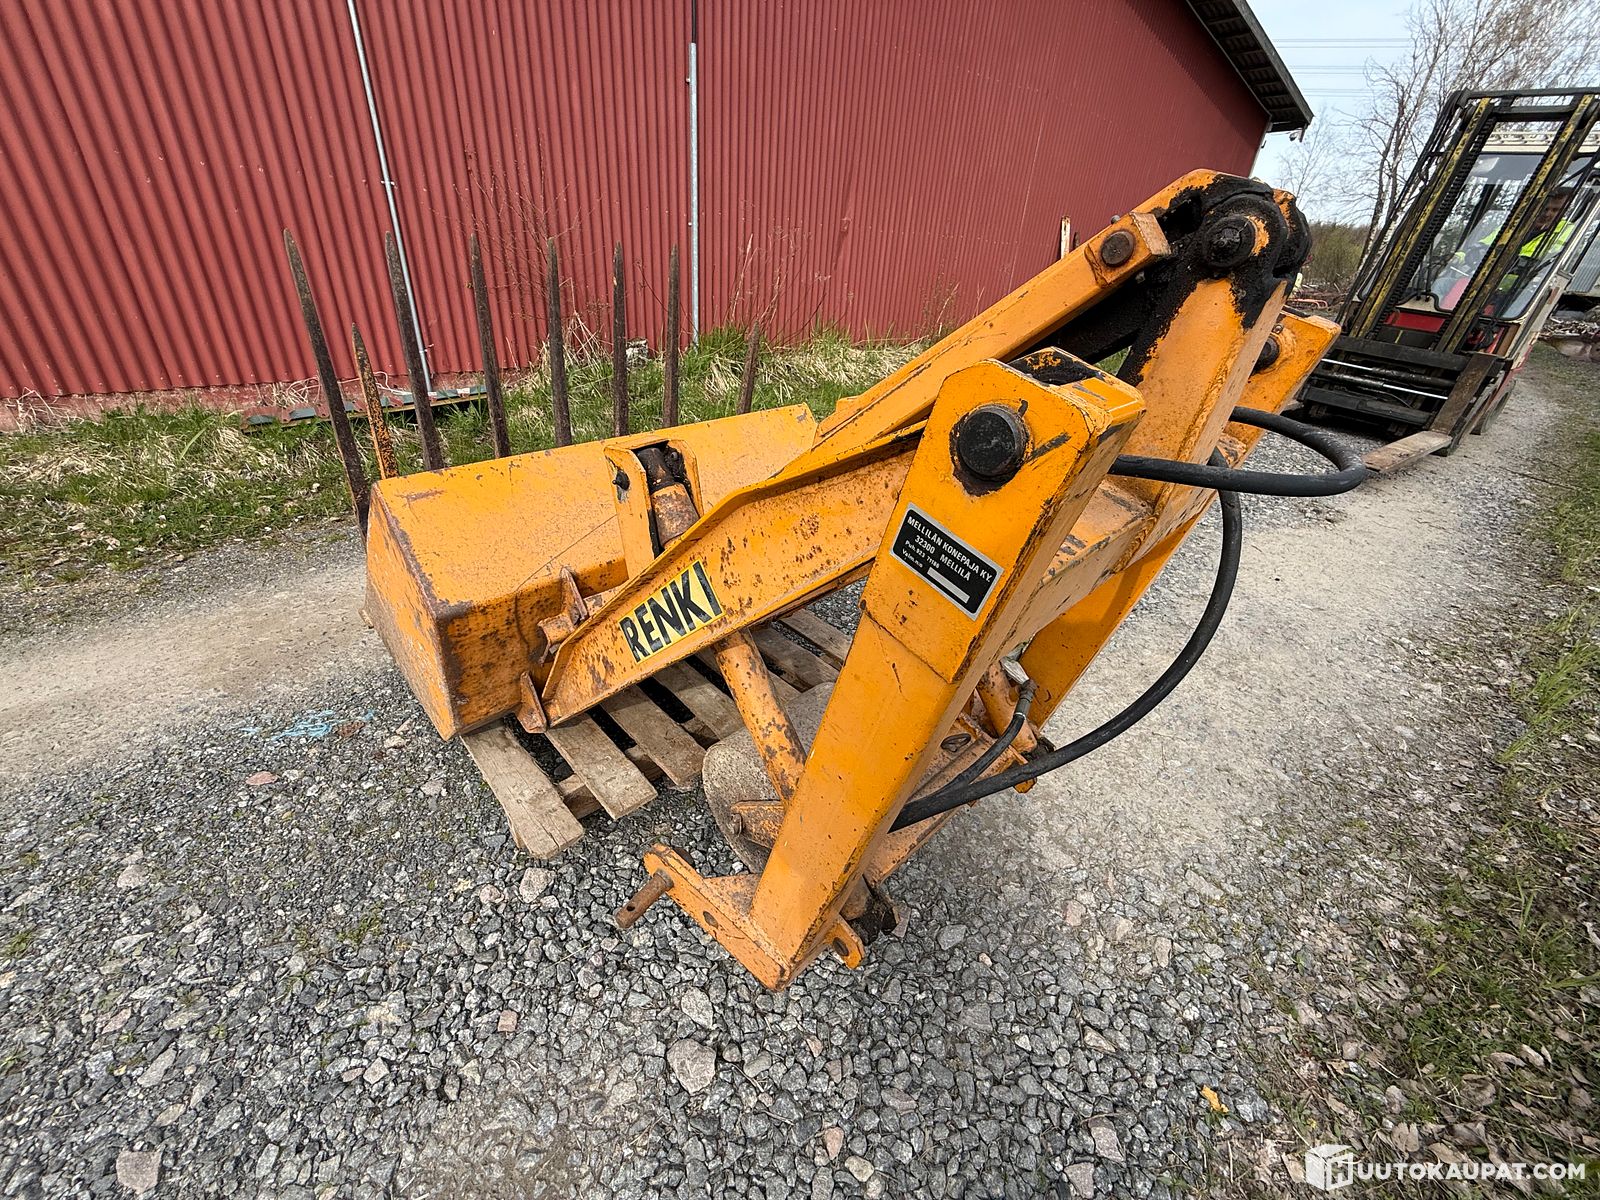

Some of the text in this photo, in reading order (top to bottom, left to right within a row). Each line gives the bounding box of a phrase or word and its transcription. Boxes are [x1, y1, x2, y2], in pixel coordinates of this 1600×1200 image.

[907, 516, 943, 546] MELLILÄN
[943, 542, 979, 574] KONEPAJA
[914, 534, 972, 581] 32300 MELLILÄ
[619, 560, 723, 663] RENKI
